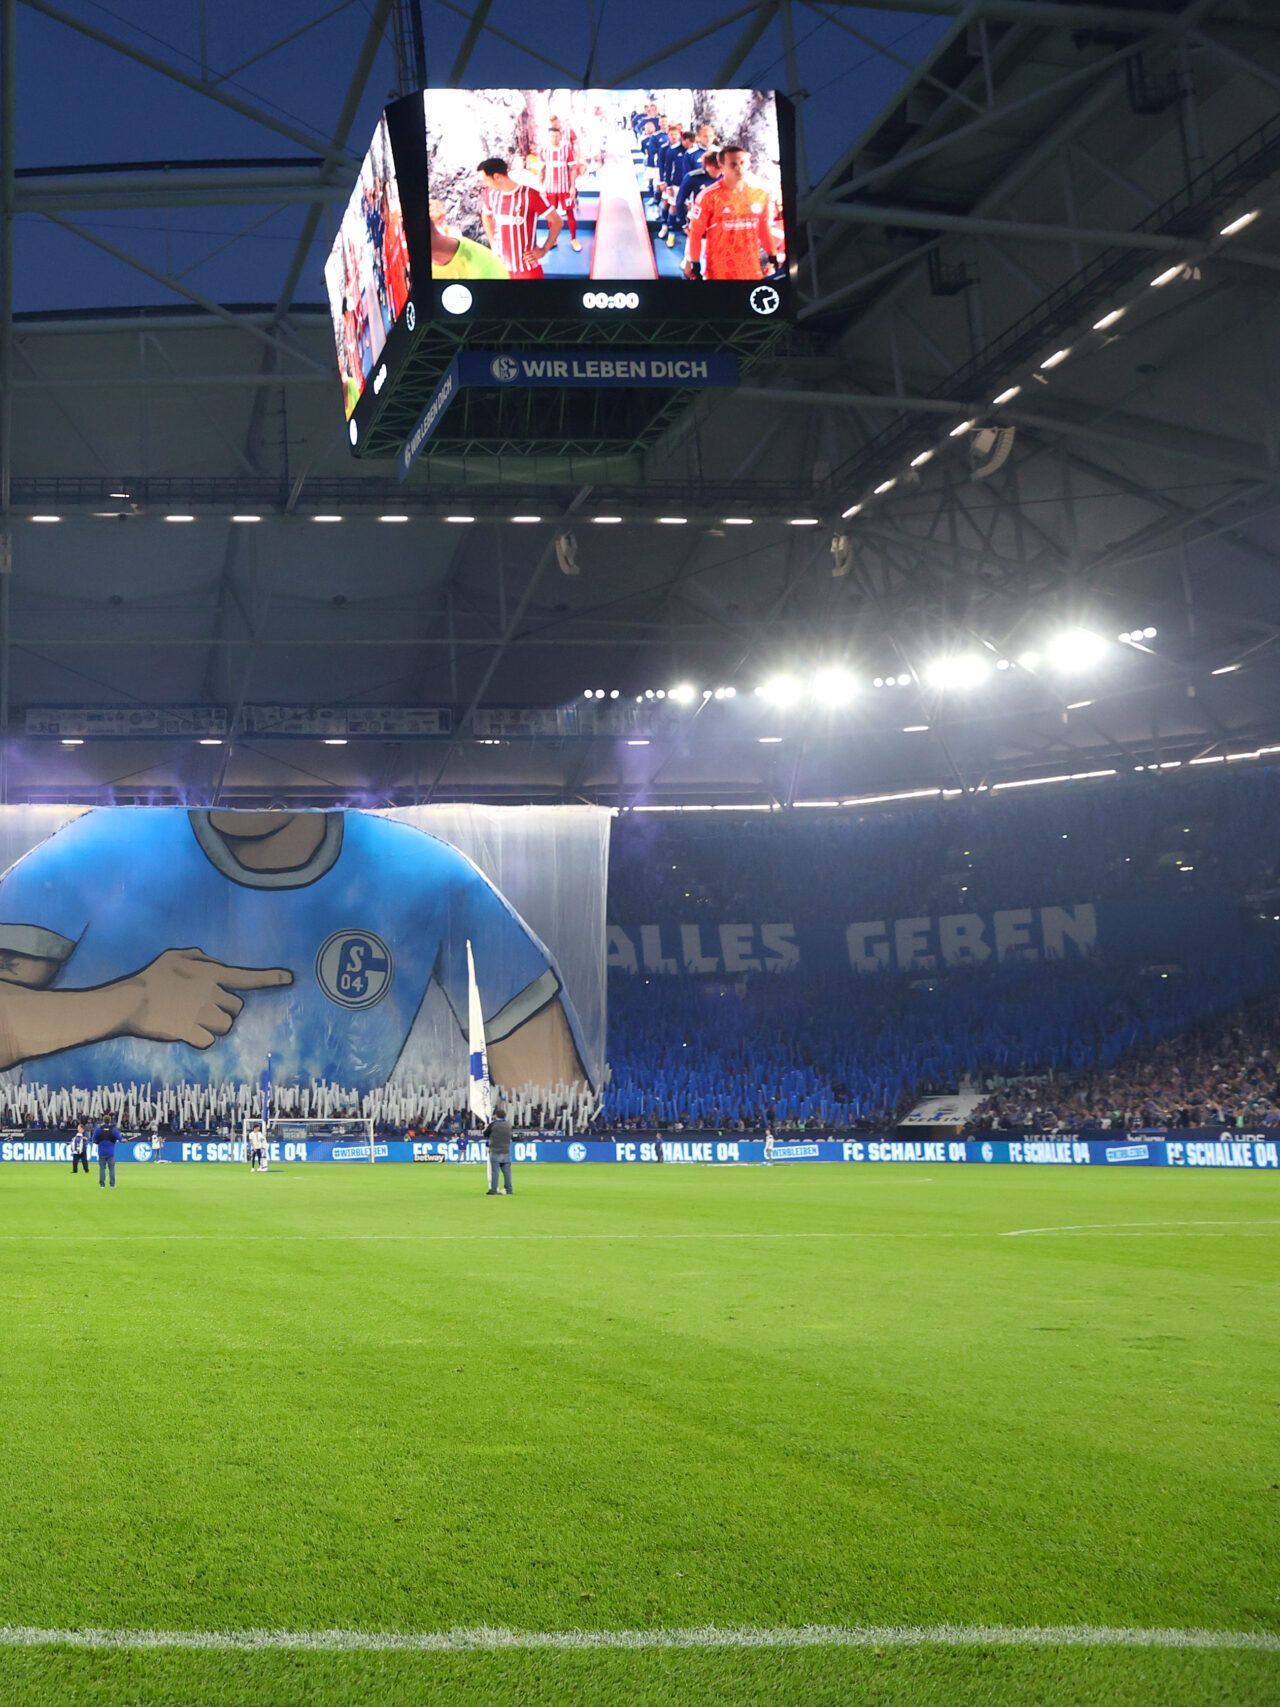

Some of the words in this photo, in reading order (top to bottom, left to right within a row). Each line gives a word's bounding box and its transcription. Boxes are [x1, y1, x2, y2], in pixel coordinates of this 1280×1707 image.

[583, 292, 640, 310] 00:00
[522, 360, 568, 378] WIR
[572, 360, 646, 378] LEBEN
[651, 360, 708, 378] DICH
[437, 374, 453, 415] DICH
[606, 923, 801, 973] ALLES
[845, 903, 1097, 973] GEBEN
[341, 973, 364, 992] 04
[182, 1143, 202, 1161] FC
[285, 1143, 307, 1161] 04
[415, 1154, 444, 1162] betway
[515, 1143, 537, 1161] 04
[616, 1143, 636, 1161] FC
[717, 1143, 739, 1161] 04
[843, 1143, 864, 1161] FC
[868, 1143, 945, 1161] SCHALKE
[948, 1143, 966, 1161] 04
[1008, 1143, 1023, 1162] FC
[1023, 1143, 1071, 1163] SCHALKE
[1072, 1143, 1090, 1163] 04
[1166, 1143, 1185, 1165] FC
[1187, 1143, 1254, 1167] SCHALKE
[1255, 1143, 1279, 1168] 04
